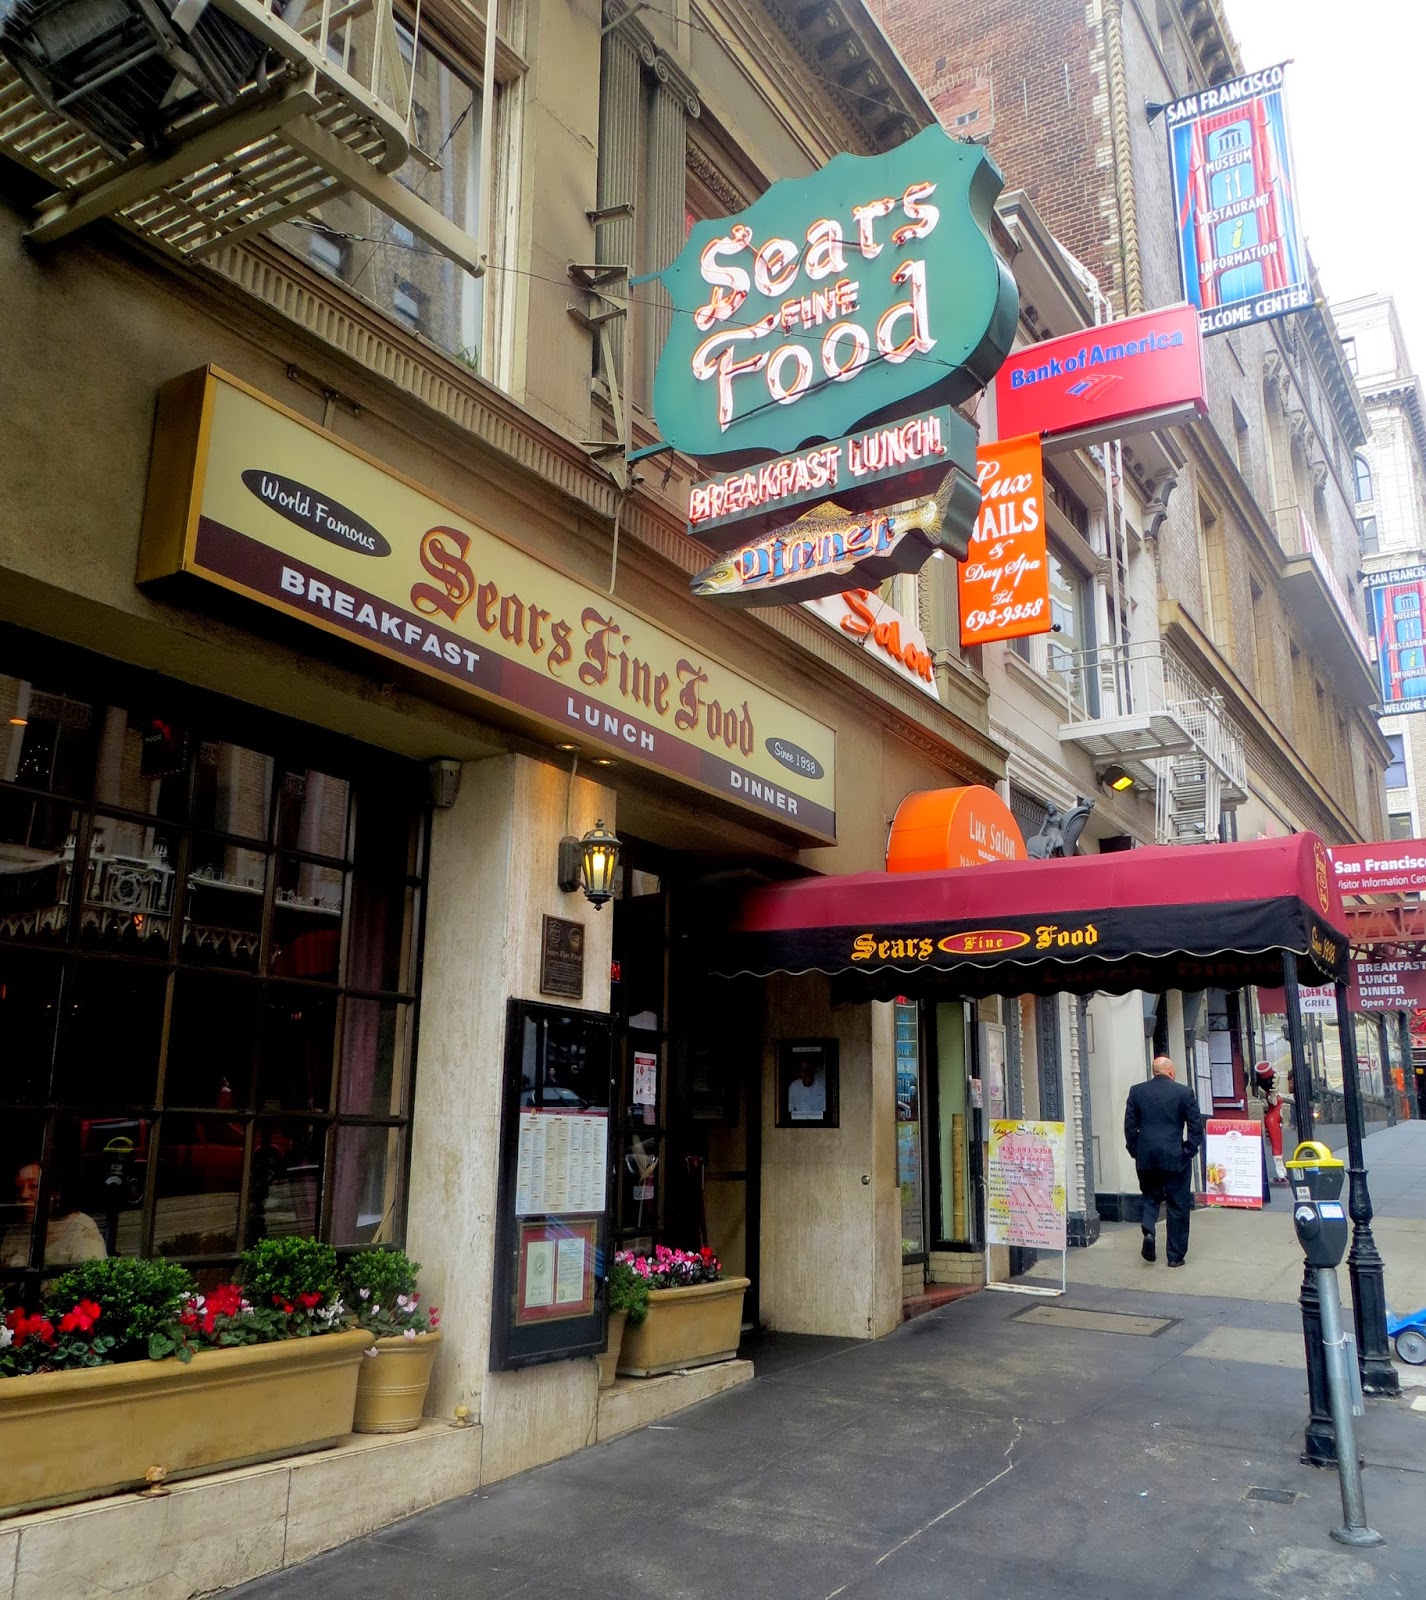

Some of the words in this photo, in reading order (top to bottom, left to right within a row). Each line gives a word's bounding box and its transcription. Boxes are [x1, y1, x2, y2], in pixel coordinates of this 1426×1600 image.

[1167, 102, 1197, 123] SAN
[1201, 67, 1283, 113] FRANCISCO
[1206, 149, 1251, 174] MUSEUM
[1200, 192, 1270, 225] RESTAURANT
[694, 181, 938, 331] Sears
[1200, 242, 1278, 275] INFORMATION
[781, 279, 860, 336] FINE
[1201, 304, 1252, 332] ELCOME
[1255, 290, 1308, 317] CENTER
[692, 260, 937, 433] Food
[1011, 361, 1063, 390] Bank
[1064, 350, 1087, 373] of
[1090, 329, 1184, 366] America
[689, 446, 841, 526] BREAKFAST
[848, 416, 948, 477] LUNCH
[976, 461, 1032, 501] Lux
[261, 476, 311, 518] World
[315, 502, 376, 551] Famous
[736, 517, 895, 583] Dinner
[989, 540, 1014, 560] &
[964, 563, 1004, 592] Day
[1005, 553, 1041, 587] Spa
[1370, 573, 1387, 586] SAN
[1389, 566, 1426, 582] FRANCIS
[280, 565, 480, 673] BREAKFAST
[965, 598, 1044, 631] 693-9358
[1393, 610, 1420, 620] MUSEUM
[410, 525, 573, 678] Sears
[578, 606, 670, 717] Fine
[675, 659, 755, 758] Food
[840, 588, 933, 683] Salon
[1390, 639, 1426, 650] RESTAURAN
[567, 697, 654, 752] LUNCH
[1383, 701, 1421, 714] WELCOME
[773, 742, 794, 765] Since
[730, 770, 798, 816] DINNER
[970, 811, 987, 846] Lux
[990, 823, 1016, 860] Salon
[1335, 861, 1361, 874] San
[1365, 855, 1426, 871] Francisc
[1362, 876, 1408, 888] Information
[851, 933, 934, 961] Sears
[963, 936, 1004, 951] Fine
[1035, 923, 1098, 950] Food
[1357, 960, 1426, 973] BREAKFAST
[1358, 974, 1398, 984] LUNCH
[1305, 999, 1331, 1007] GRILL
[1360, 985, 1405, 997] DINNER
[1361, 998, 1384, 1009] Open
[1387, 998, 1393, 1006] 7
[1395, 997, 1418, 1008] Days
[1212, 1121, 1231, 1132] HAPPY
[1233, 1122, 1251, 1133] HOUR
